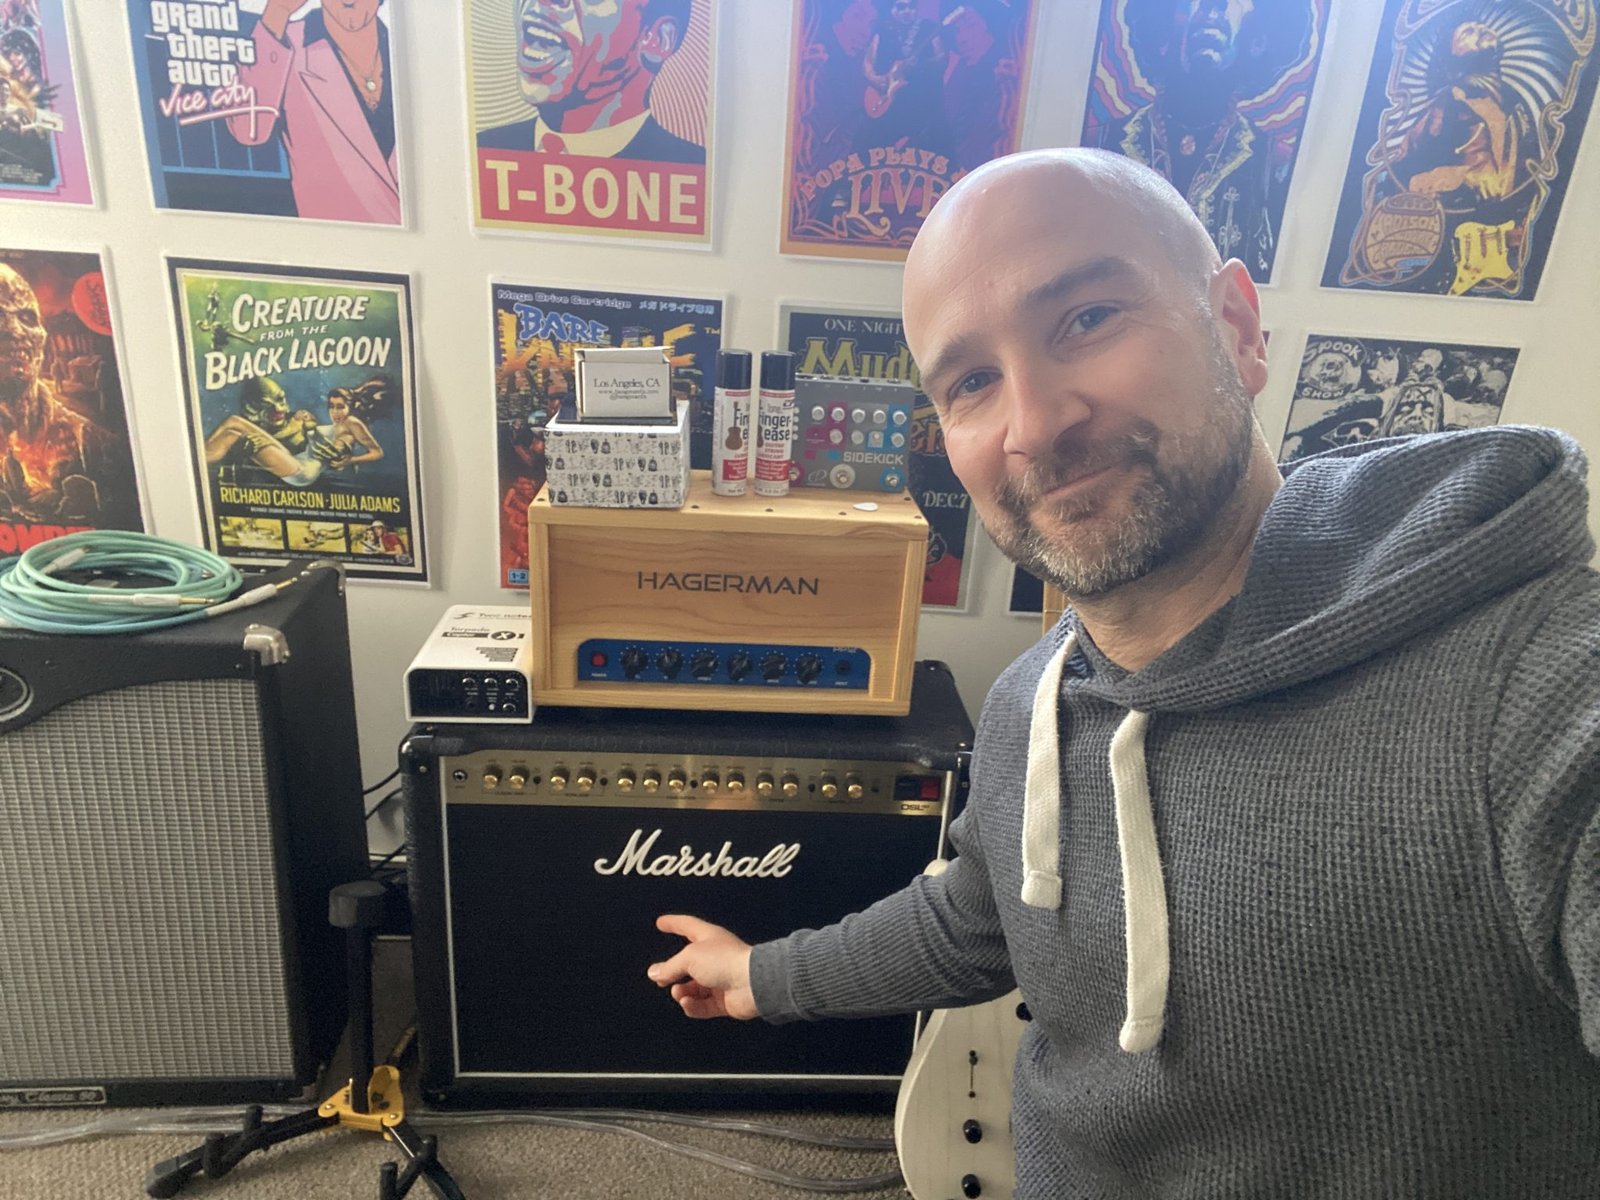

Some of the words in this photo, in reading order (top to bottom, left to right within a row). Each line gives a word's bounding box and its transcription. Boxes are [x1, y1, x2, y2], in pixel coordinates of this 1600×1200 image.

[151, 1, 238, 34] grand
[166, 30, 255, 63] theft
[168, 60, 237, 86] auto
[160, 84, 207, 117] Vice
[800, 153, 864, 200] POPA
[869, 146, 949, 175] PLAYS
[486, 160, 697, 225] T-BONE
[497, 289, 534, 303] Mega
[535, 292, 569, 304] Drive
[571, 295, 632, 309] Cartridge
[231, 293, 370, 333] CREATURE
[513, 303, 609, 343] BARE
[260, 328, 294, 342] FROM
[302, 324, 329, 336] THE
[825, 318, 857, 333] ONE
[863, 320, 902, 335] NIGH
[204, 346, 284, 391] BLACK
[288, 336, 392, 370] LAGOON
[1302, 340, 1361, 363] SPOOK
[593, 378, 609, 388] Los
[611, 378, 645, 389] Angeles,
[646, 378, 661, 388] CA
[1301, 386, 1345, 399] SHOW
[764, 429, 790, 441] ease
[843, 451, 905, 465] SIDEKICK
[219, 487, 271, 506] RICHARD
[273, 490, 324, 509] CARLSON
[328, 493, 357, 510] JULIA
[359, 496, 401, 513] ADAMS
[637, 571, 819, 596] HAGERMAN
[594, 828, 801, 878] Marshall
